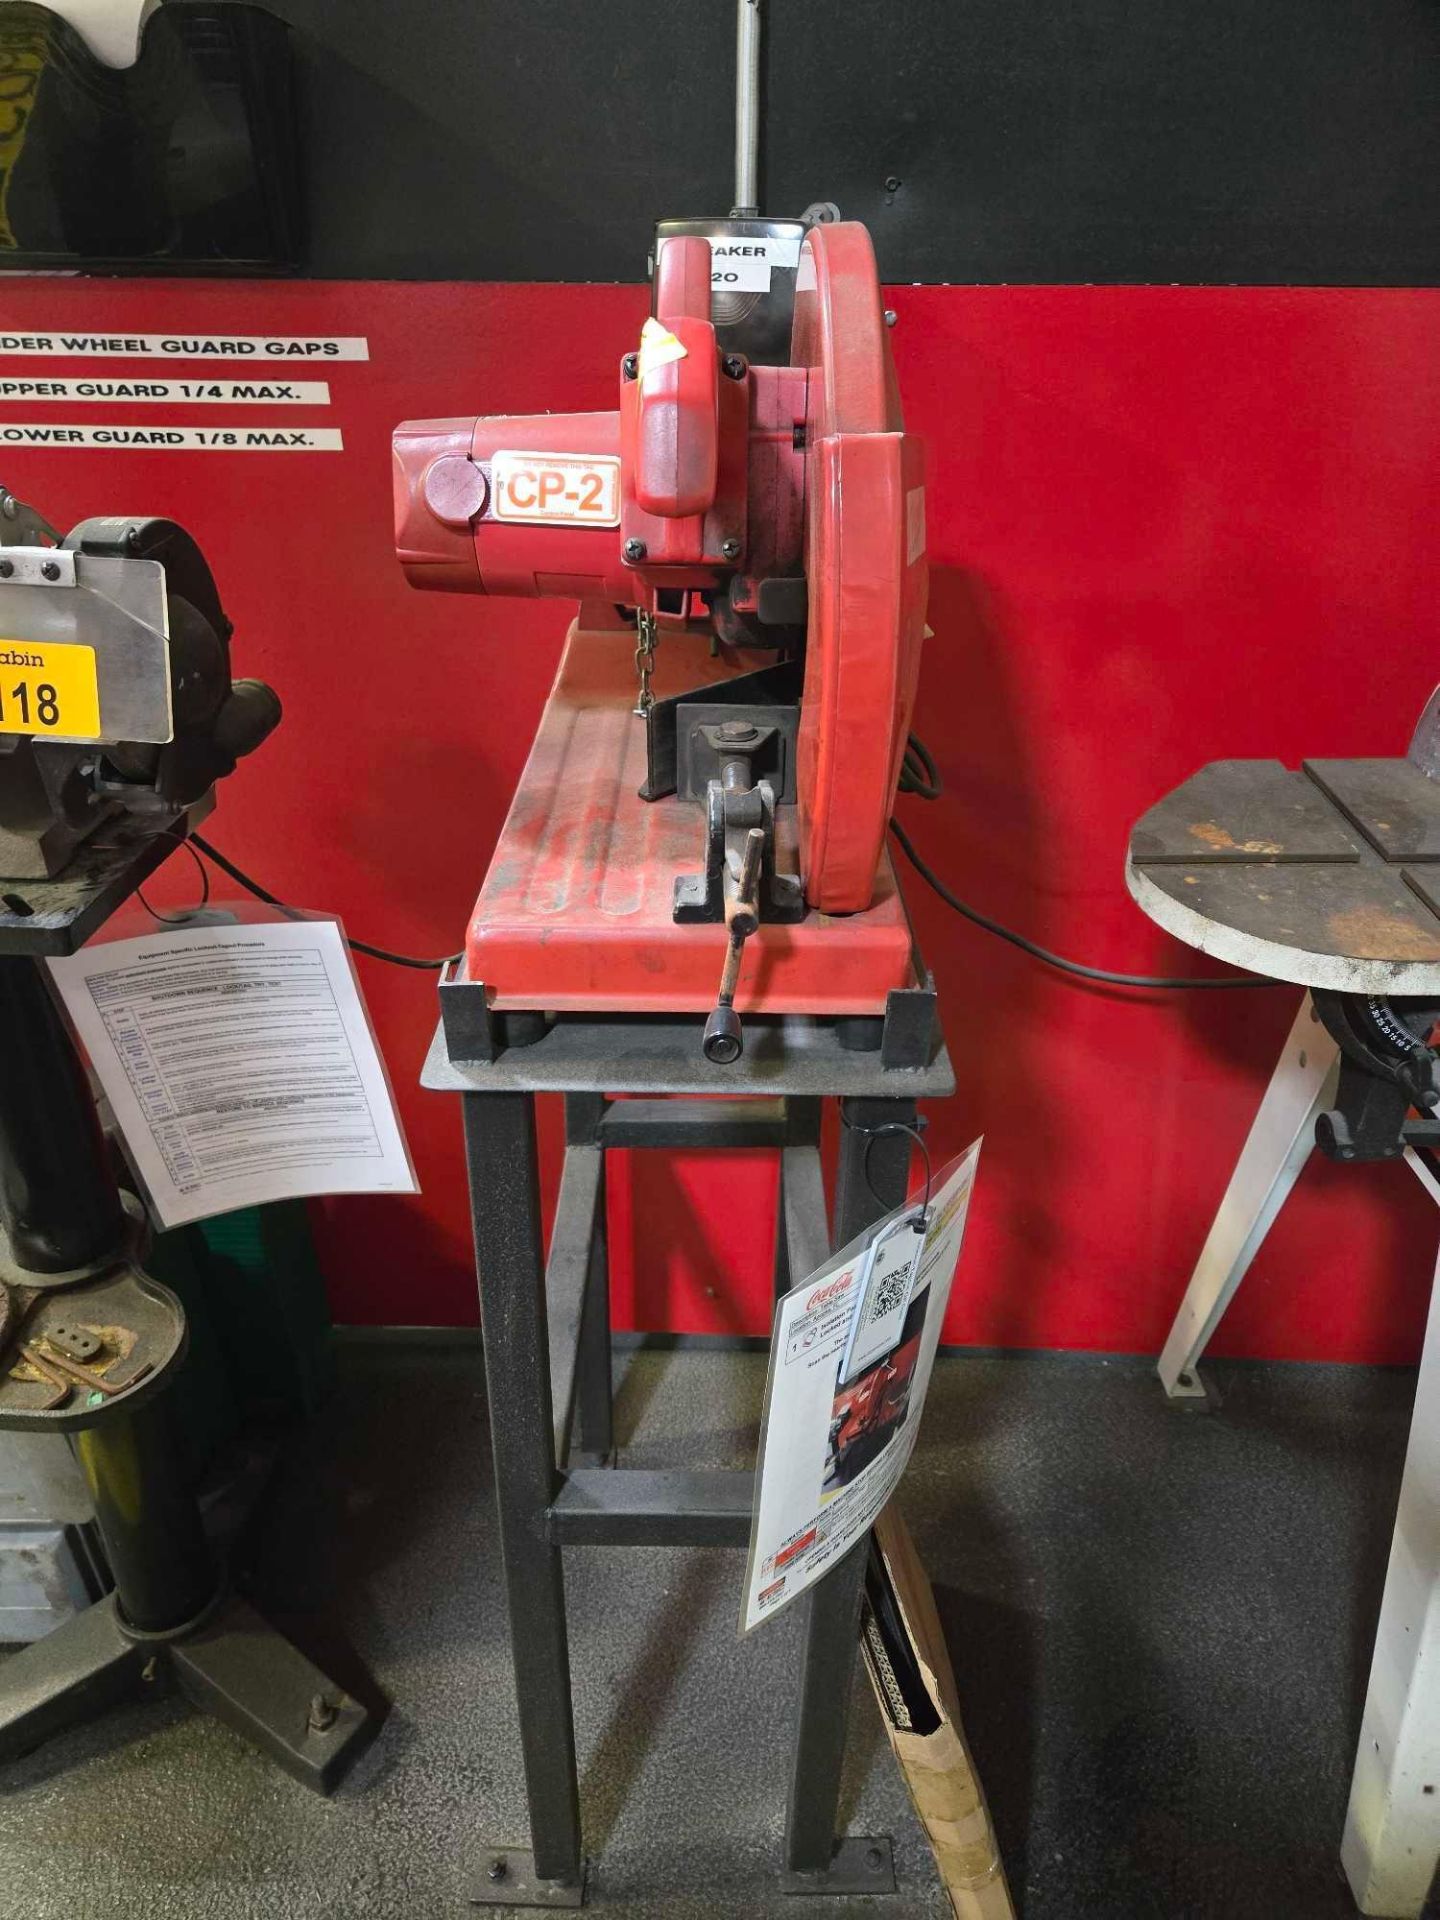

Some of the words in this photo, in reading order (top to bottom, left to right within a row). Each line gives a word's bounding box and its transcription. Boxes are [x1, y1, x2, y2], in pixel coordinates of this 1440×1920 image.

[711, 246, 766, 257] AKER
[0, 337, 53, 350] DER
[60, 338, 152, 352] WHEEL
[161, 340, 256, 355] GUARD
[265, 341, 340, 356] GAPS
[0, 383, 67, 395] PPER
[76, 384, 169, 397] GUARD
[180, 385, 223, 398] 1/4
[231, 386, 301, 399] MAX.
[92, 431, 184, 444] GUARD
[195, 432, 238, 445] 1/8
[246, 433, 314, 446] MAX.
[507, 470, 603, 511] CP-2
[1381, 1026, 1391, 1034] 20
[1389, 1032, 1397, 1040] 15
[1395, 1039, 1405, 1047] 10
